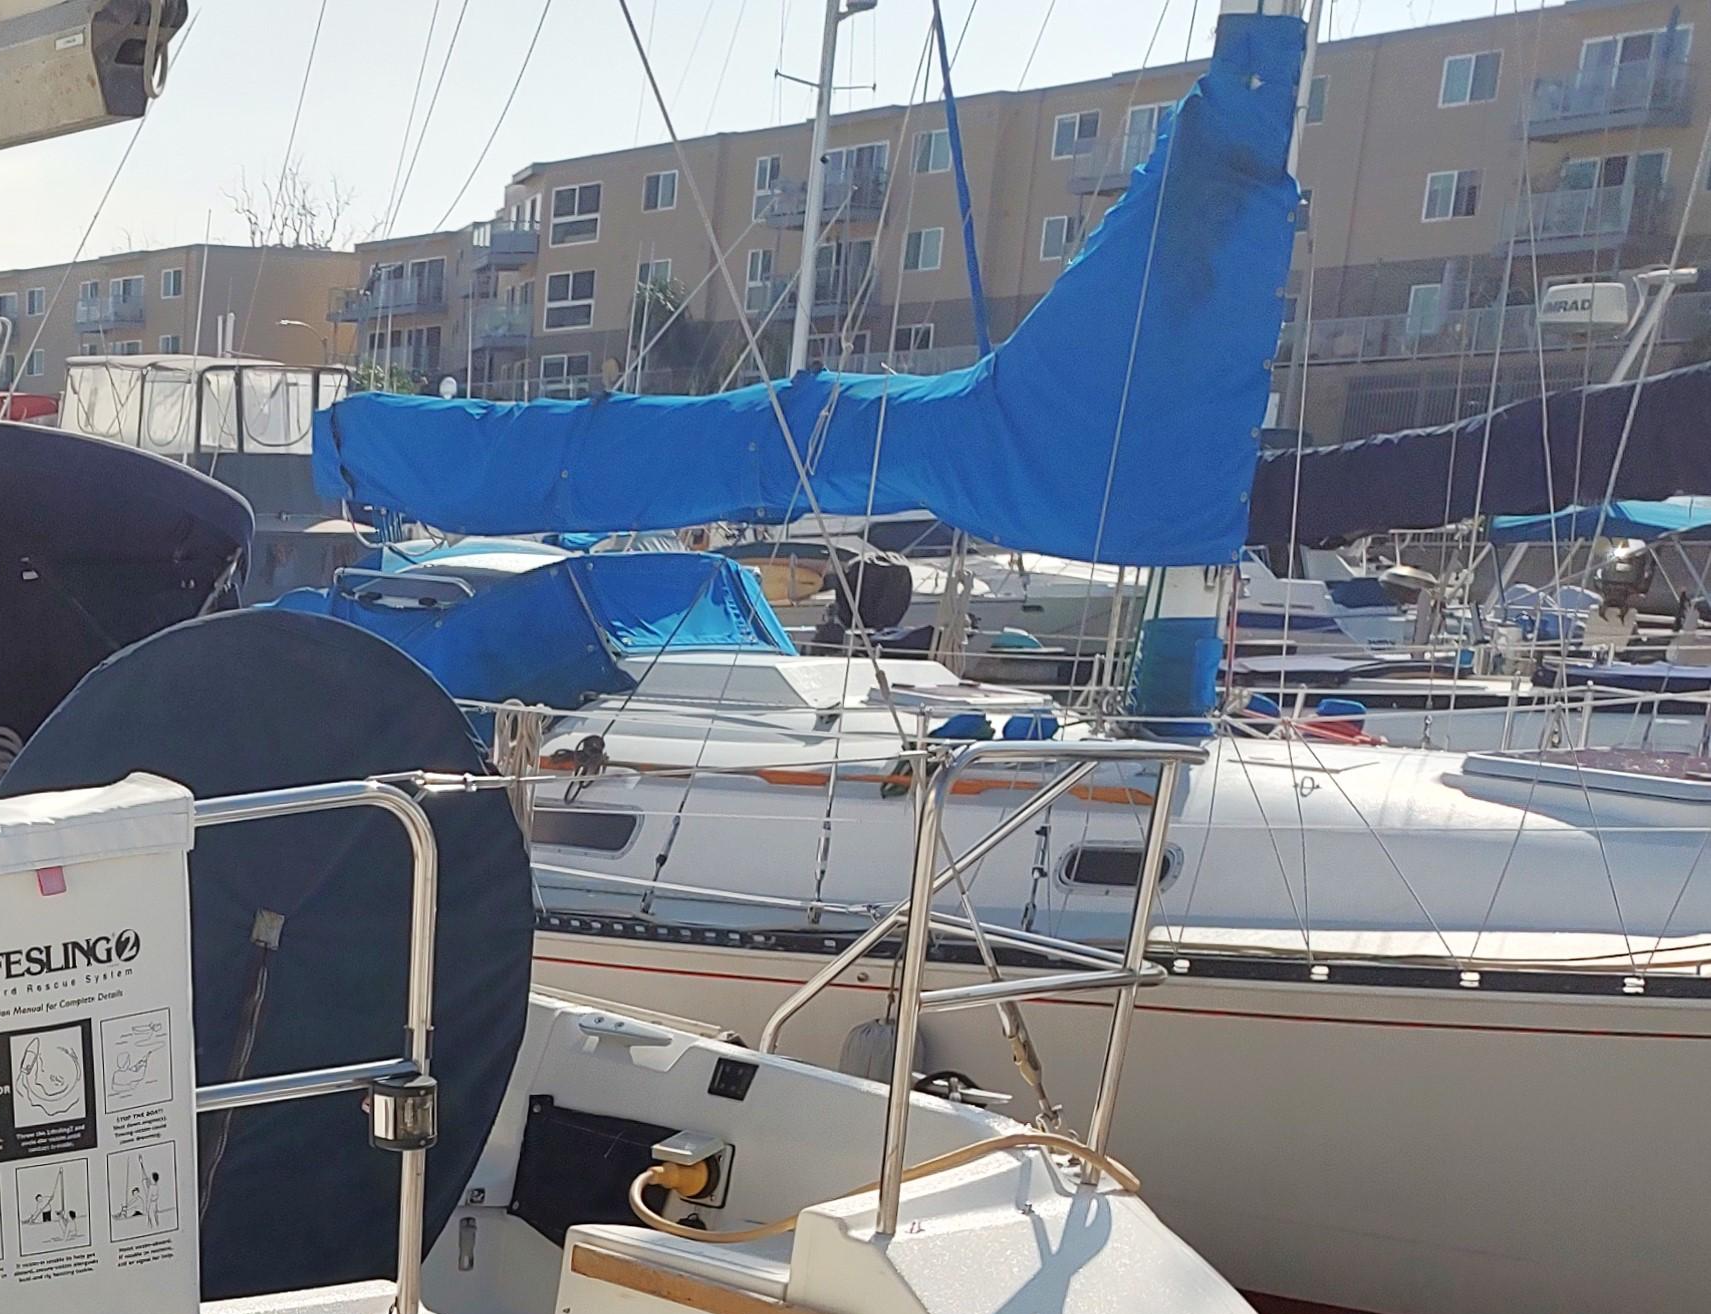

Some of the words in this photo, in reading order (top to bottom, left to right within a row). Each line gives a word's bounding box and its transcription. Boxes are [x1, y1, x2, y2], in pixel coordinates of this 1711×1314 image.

[26, 979, 76, 993] Rescue
[85, 967, 133, 984] System
[13, 1003, 44, 1016] Manual
[45, 1002, 57, 1013] for
[97, 989, 124, 1002] Details
